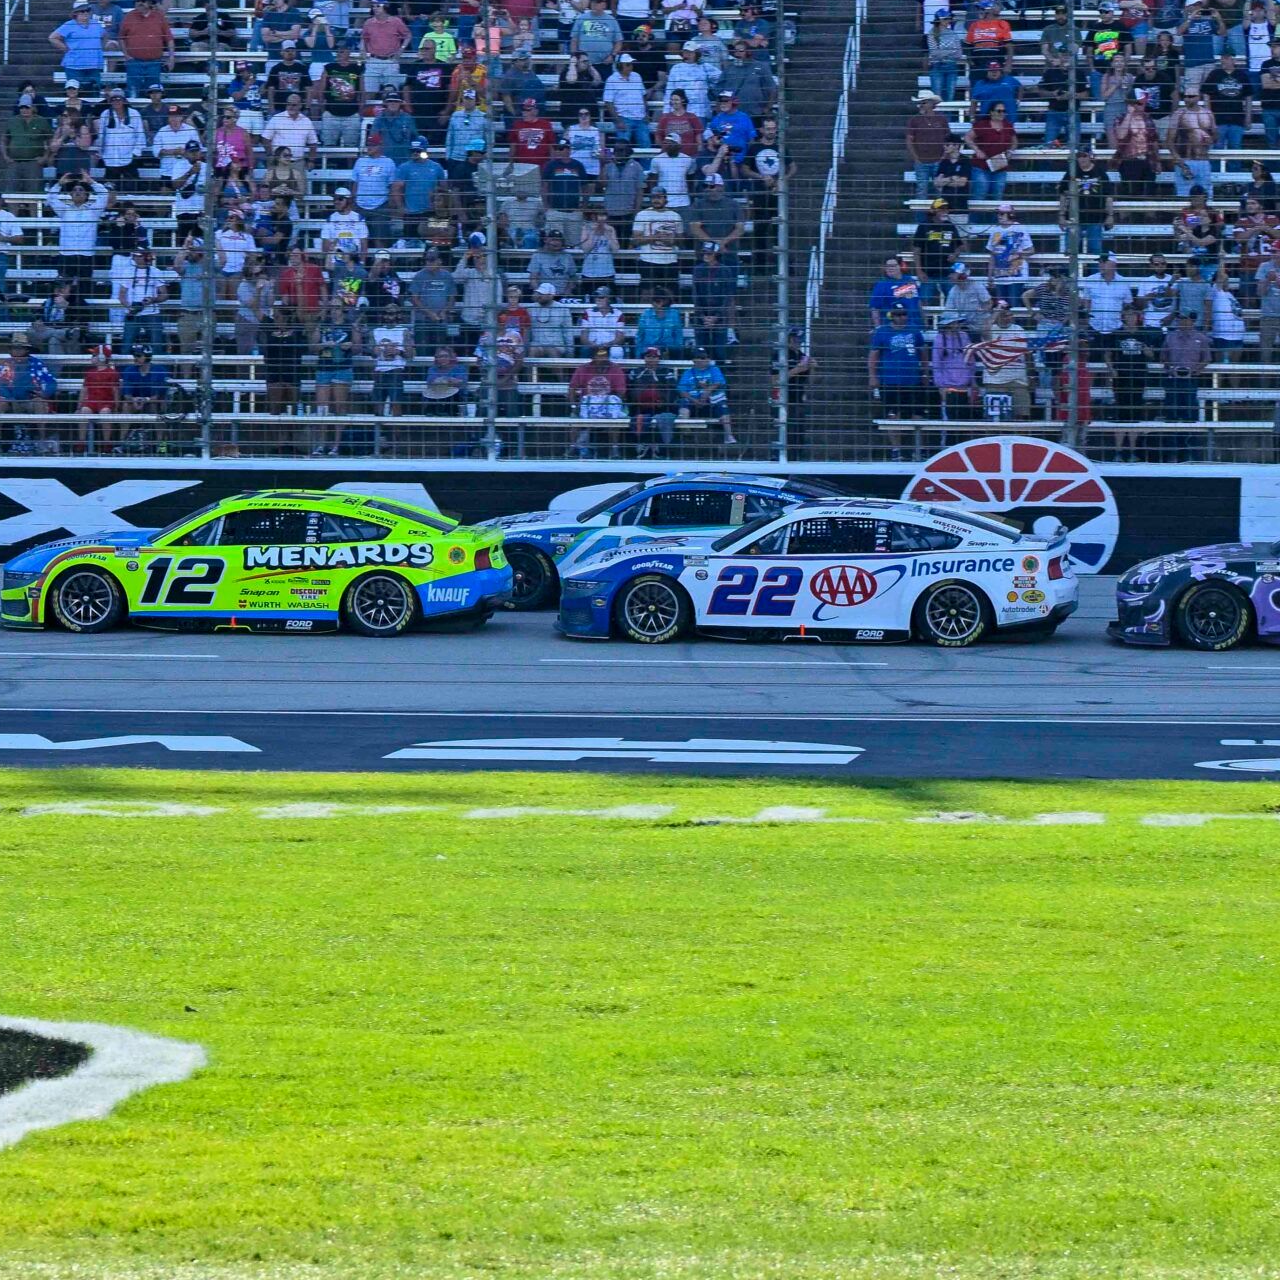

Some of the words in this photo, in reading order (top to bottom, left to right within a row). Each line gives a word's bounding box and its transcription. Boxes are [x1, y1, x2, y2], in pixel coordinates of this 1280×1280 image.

[245, 543, 434, 568] MENARDS
[632, 560, 674, 571] GOODYEAR
[911, 557, 1015, 577] Insurance
[139, 556, 226, 606] 12
[706, 565, 804, 616] 22
[819, 566, 871, 605] AAA
[239, 588, 280, 597] Snap-on
[856, 629, 884, 637] FORD
